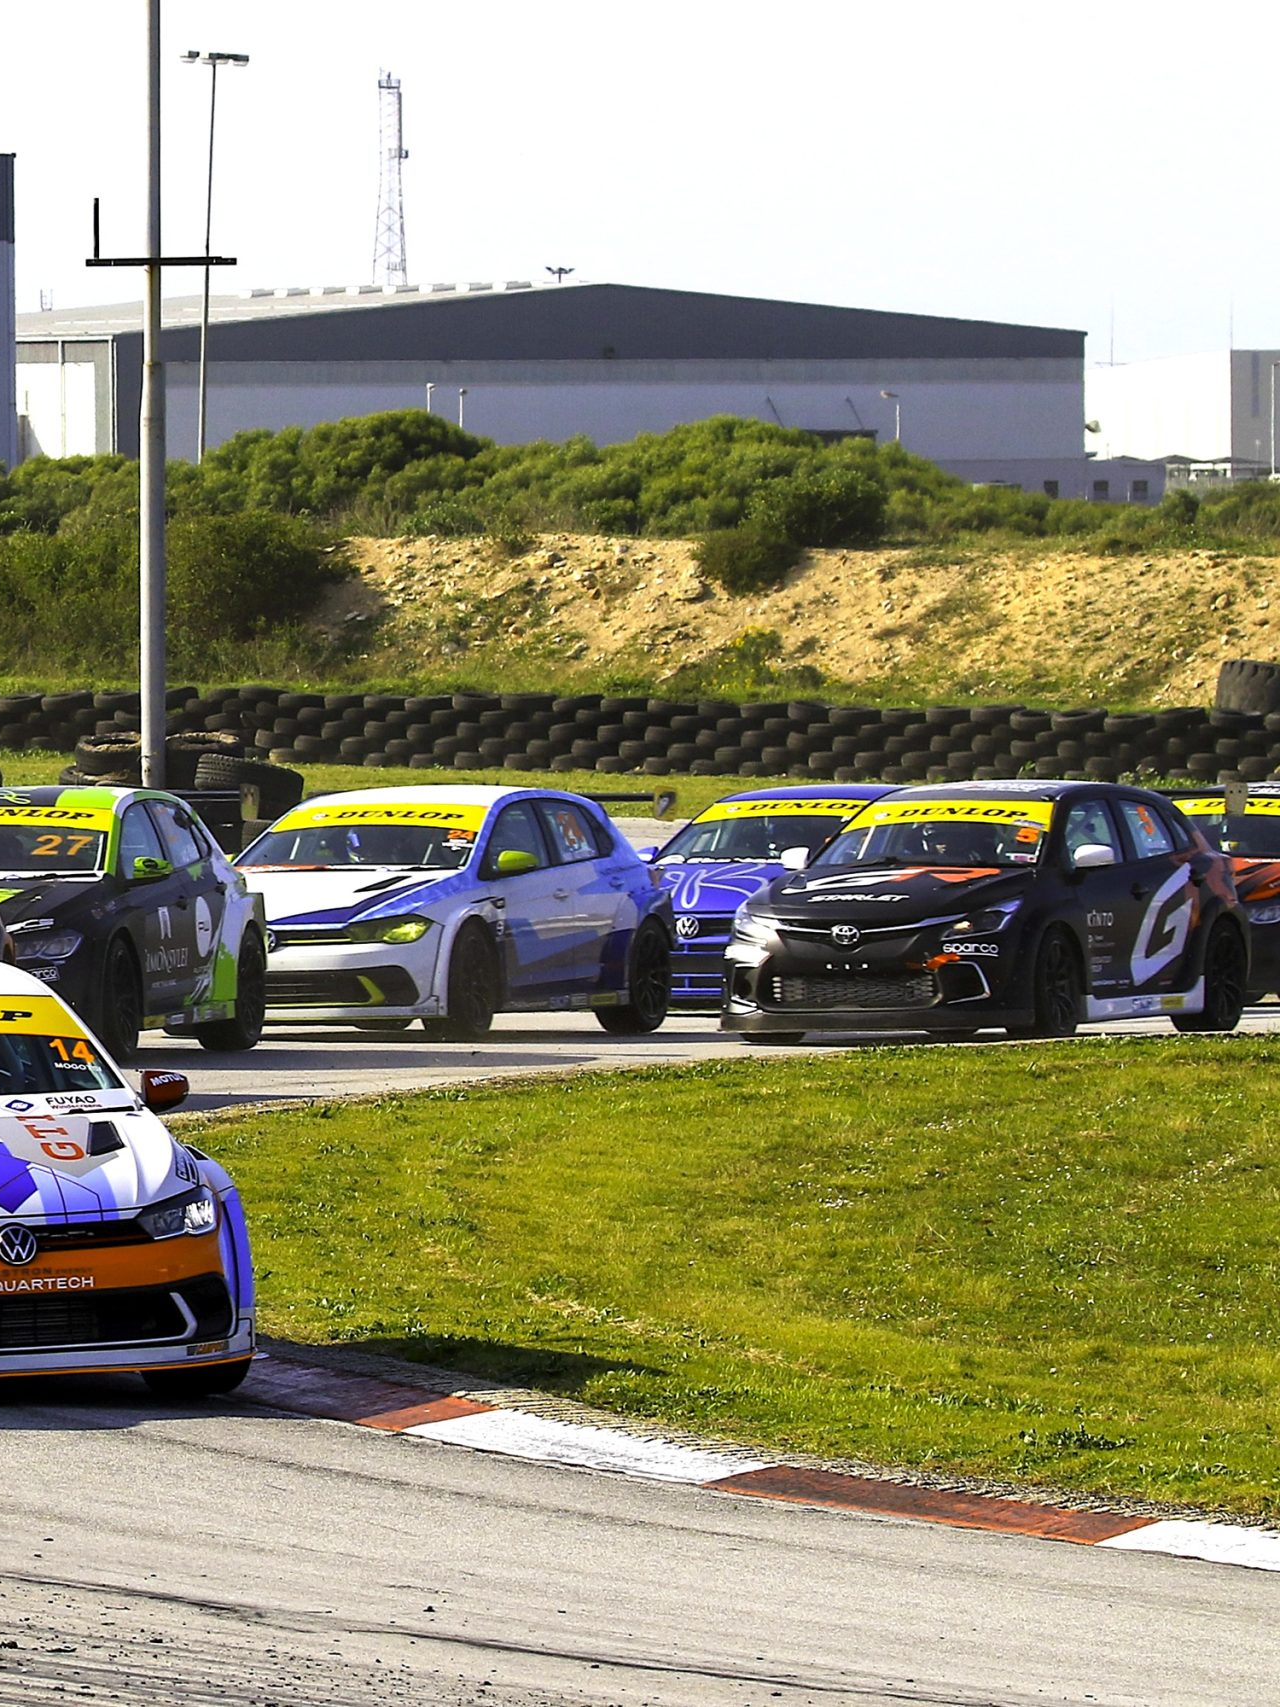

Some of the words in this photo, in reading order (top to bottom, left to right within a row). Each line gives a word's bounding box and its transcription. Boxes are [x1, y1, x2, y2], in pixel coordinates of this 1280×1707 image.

[335, 810, 465, 820] DUNLOP
[899, 807, 1029, 818] DUNLOP
[1015, 827, 1041, 843] 5
[30, 834, 95, 856] 27
[942, 942, 1000, 956] sparco
[49, 1038, 96, 1063] 14
[150, 1073, 185, 1087] MOTUL
[45, 1095, 97, 1105] FUYAO
[15, 1114, 86, 1161] GTI
